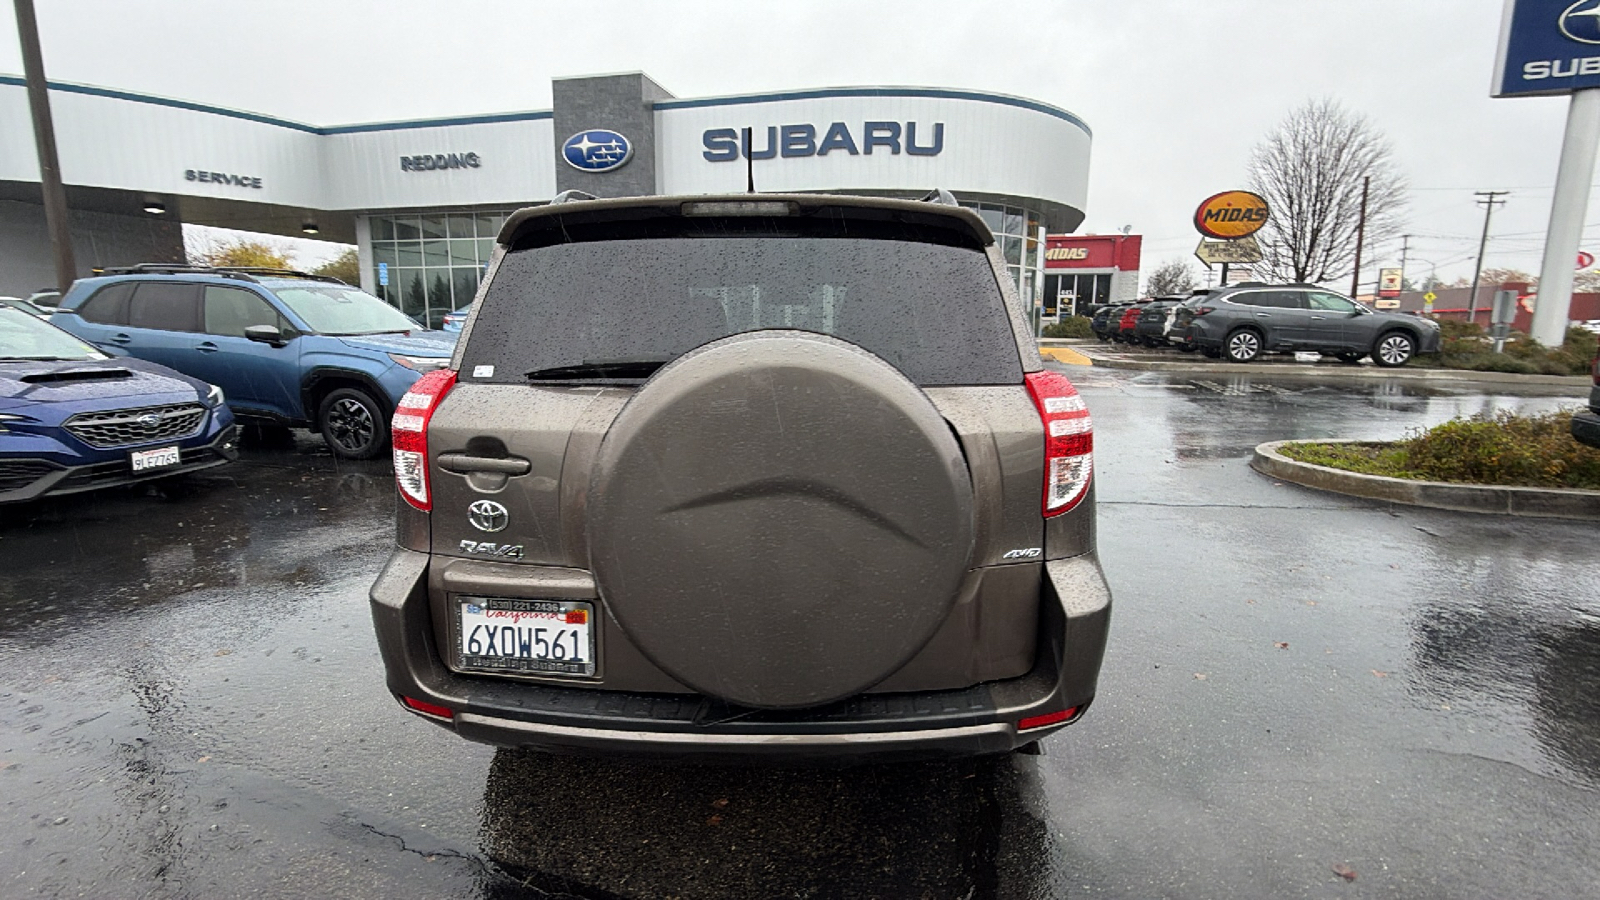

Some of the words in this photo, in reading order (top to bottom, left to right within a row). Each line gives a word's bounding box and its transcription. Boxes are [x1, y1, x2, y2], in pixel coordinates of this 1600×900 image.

[1522, 56, 1600, 80] SUB
[702, 121, 944, 162] SUBARU
[400, 151, 481, 172] REDDING
[185, 169, 263, 189] SERVICE
[1204, 207, 1266, 223] MIDAS
[459, 539, 525, 561] RAV4
